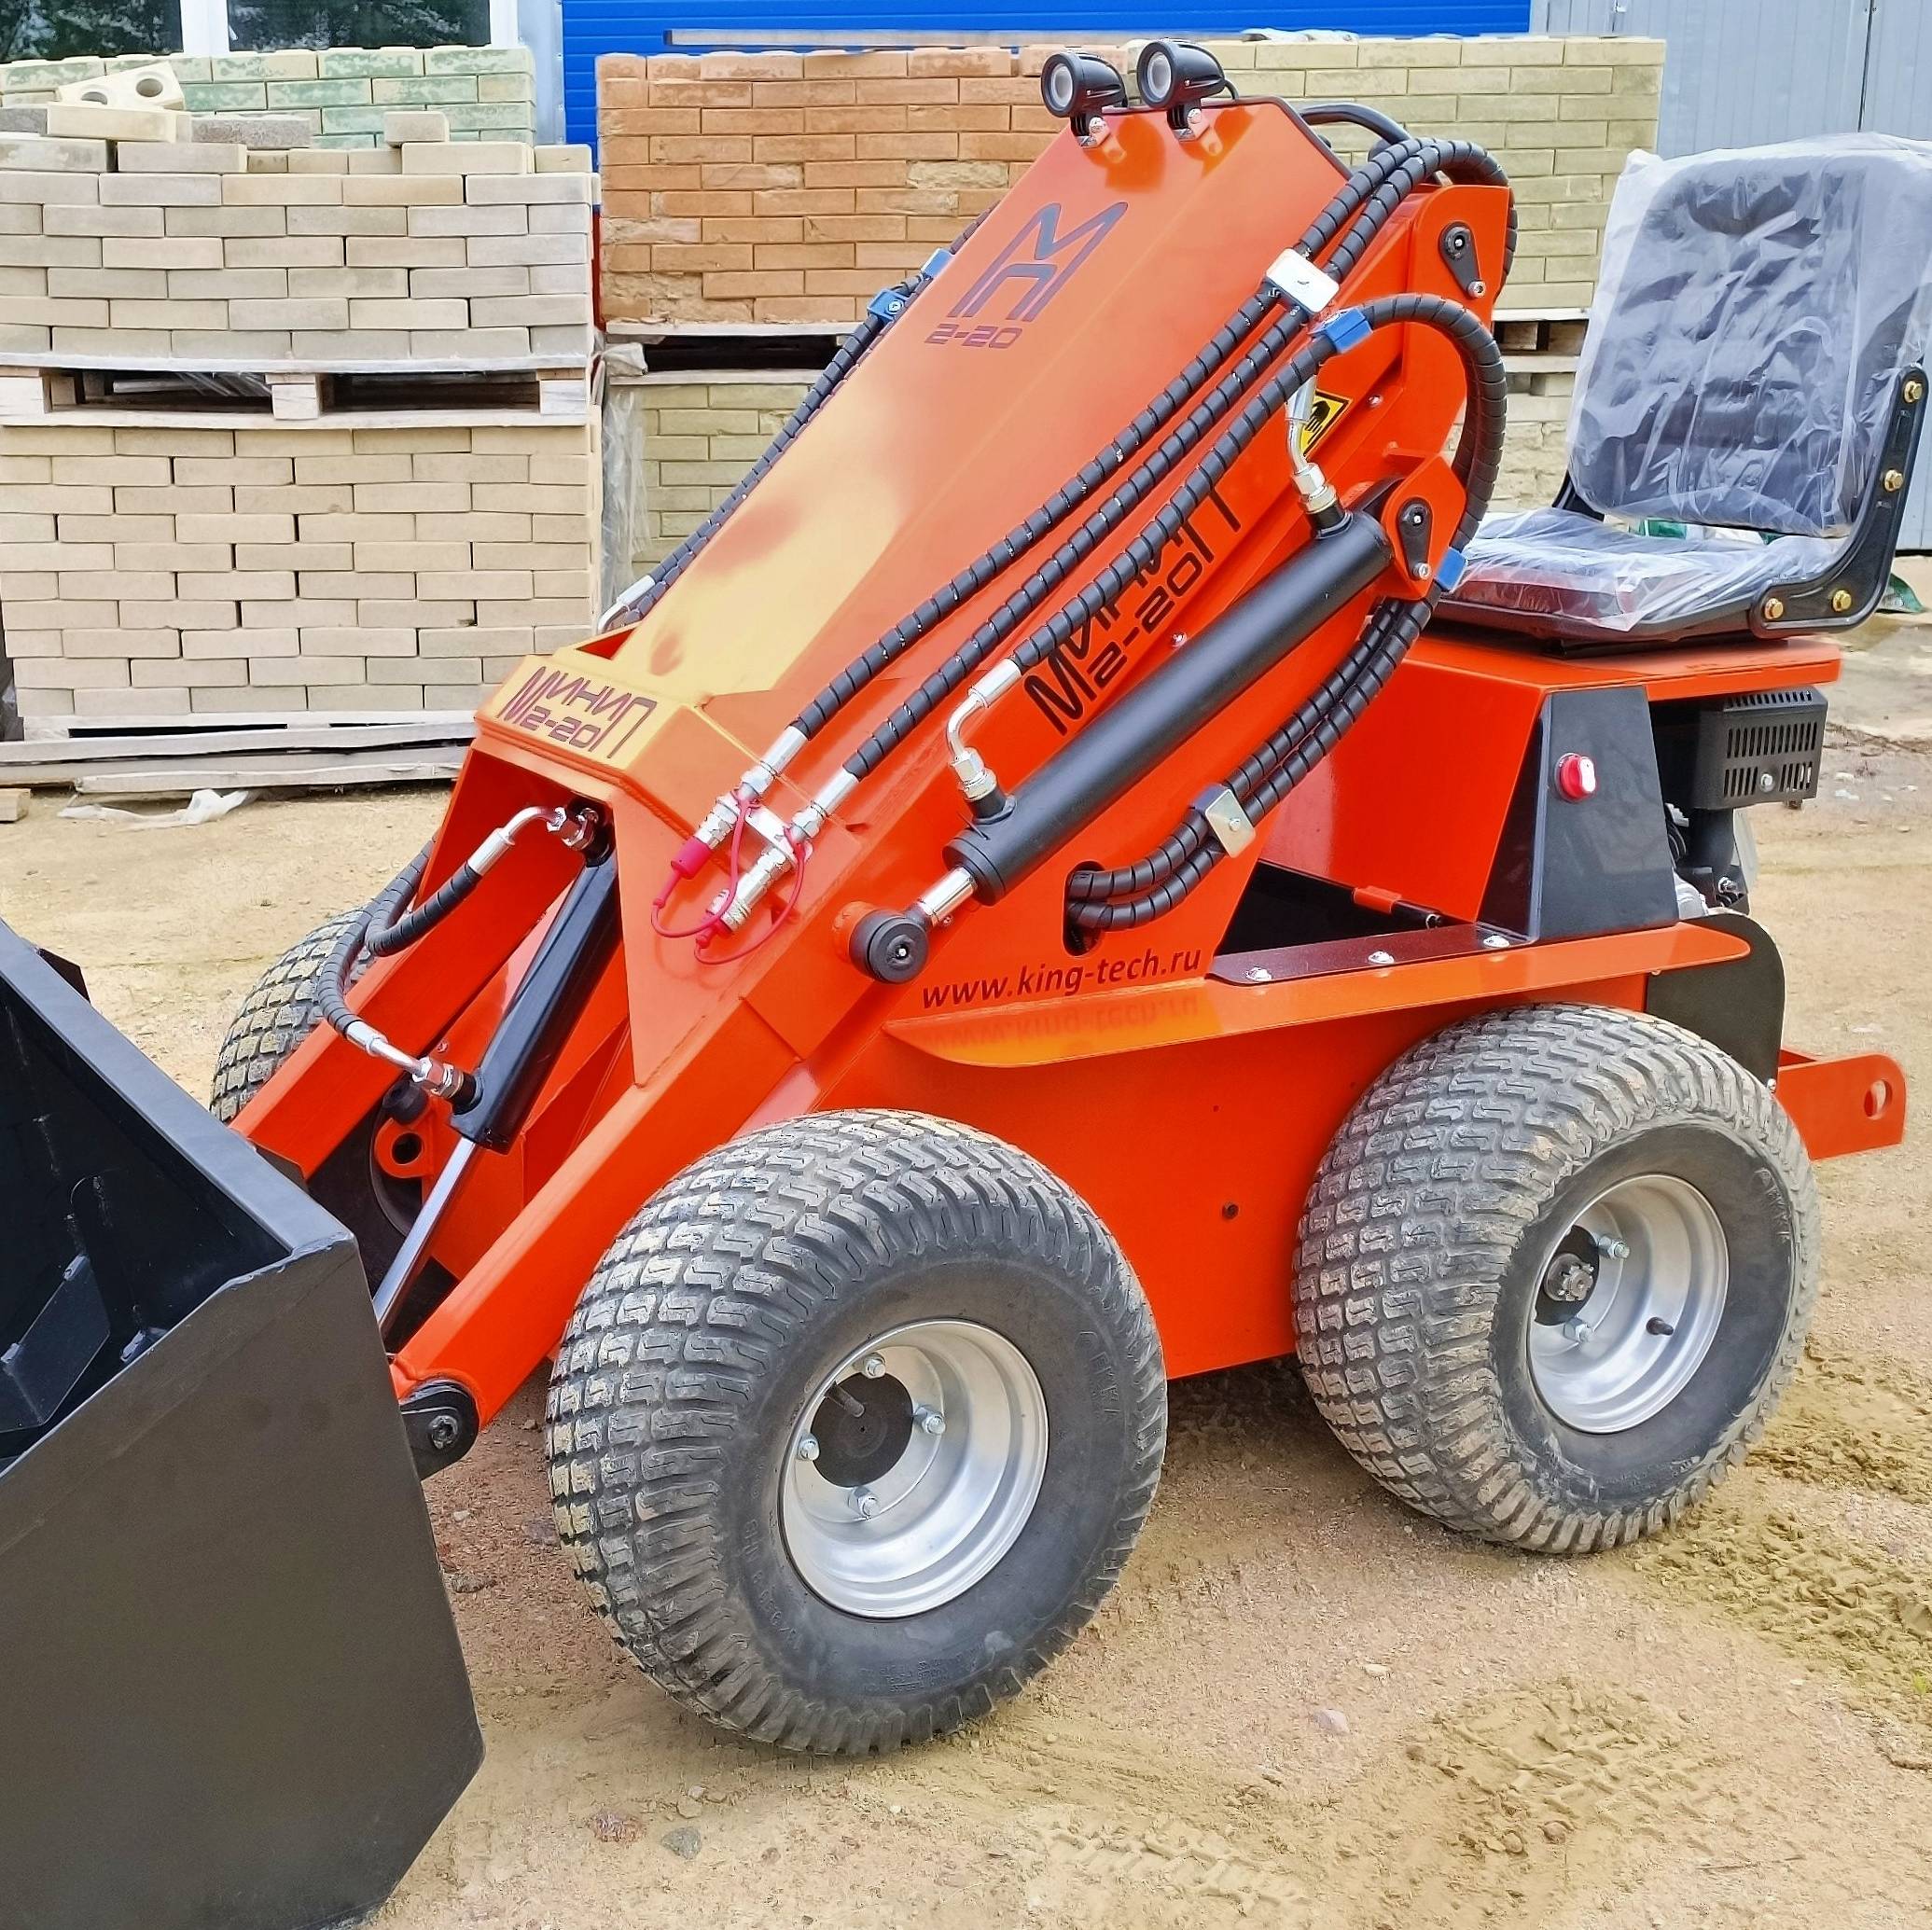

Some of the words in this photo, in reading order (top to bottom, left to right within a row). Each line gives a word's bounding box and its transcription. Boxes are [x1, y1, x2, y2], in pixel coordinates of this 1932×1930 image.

[924, 323, 1023, 349] 2-20
[1087, 551, 1203, 689] 2-20
[520, 706, 601, 748] 2-20
[923, 949, 1202, 1008] www.king-tech.ru
